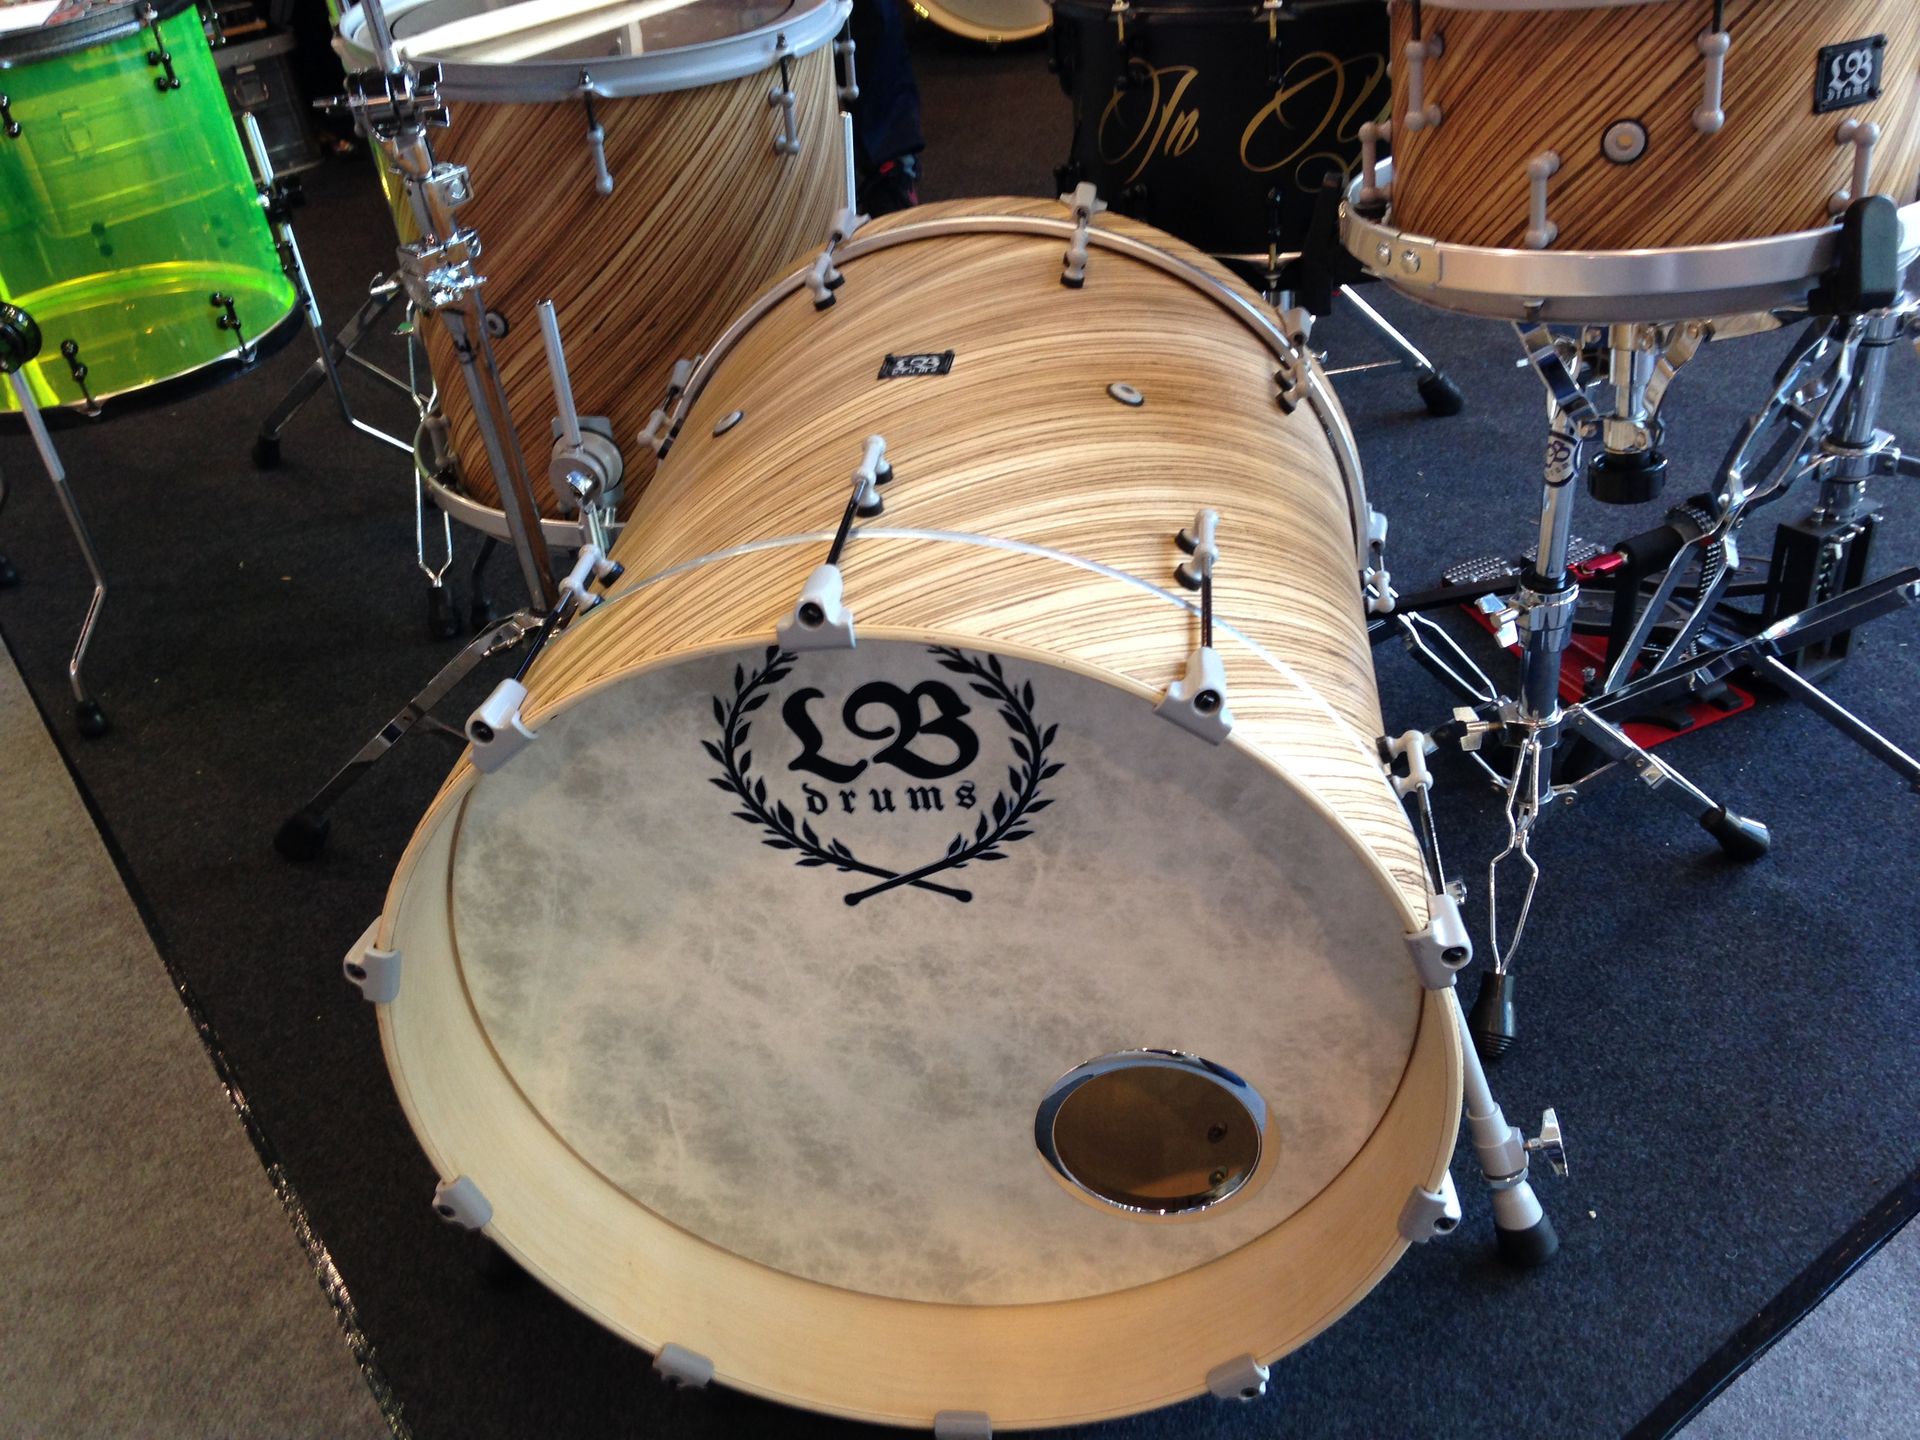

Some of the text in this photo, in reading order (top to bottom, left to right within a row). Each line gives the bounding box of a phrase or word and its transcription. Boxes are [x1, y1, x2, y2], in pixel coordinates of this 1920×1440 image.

[1828, 48, 1873, 90] LB
[782, 680, 980, 784] LB
[801, 780, 978, 815] drums
